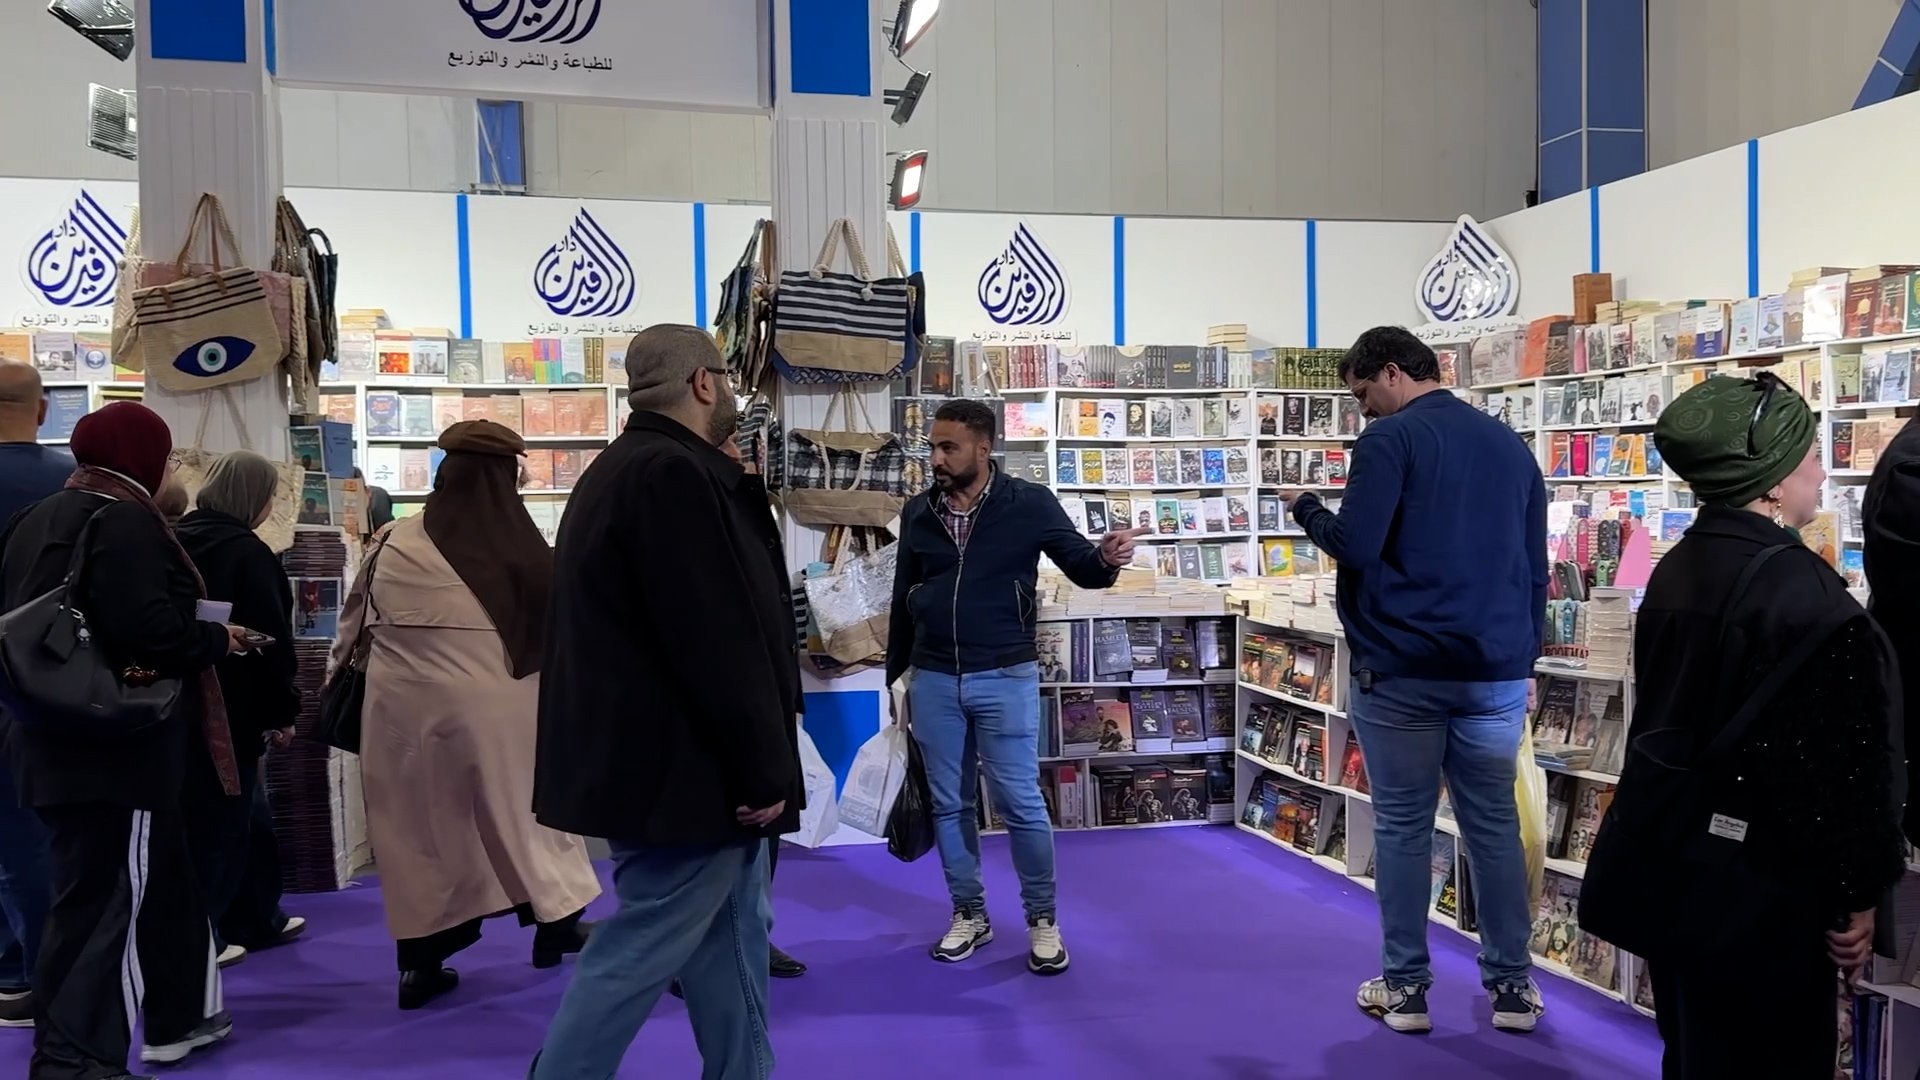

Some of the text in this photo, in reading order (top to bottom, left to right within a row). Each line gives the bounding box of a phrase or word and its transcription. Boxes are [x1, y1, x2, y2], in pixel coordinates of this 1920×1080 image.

[448, 51, 612, 72] للطباعة والنشر والتوزيع
[55, 218, 77, 238] دار
[557, 235, 577, 252] دار
[998, 249, 1015, 265] دار
[1443, 249, 1460, 265] دار
[21, 313, 109, 327] والنشر والتوزيع
[527, 322, 568, 335] والتوزيع
[573, 323, 604, 335] والنشر
[1011, 331, 1038, 342] والنشر
[1040, 330, 1072, 342] للطباعة
[1095, 633, 1128, 644] HAMLET
